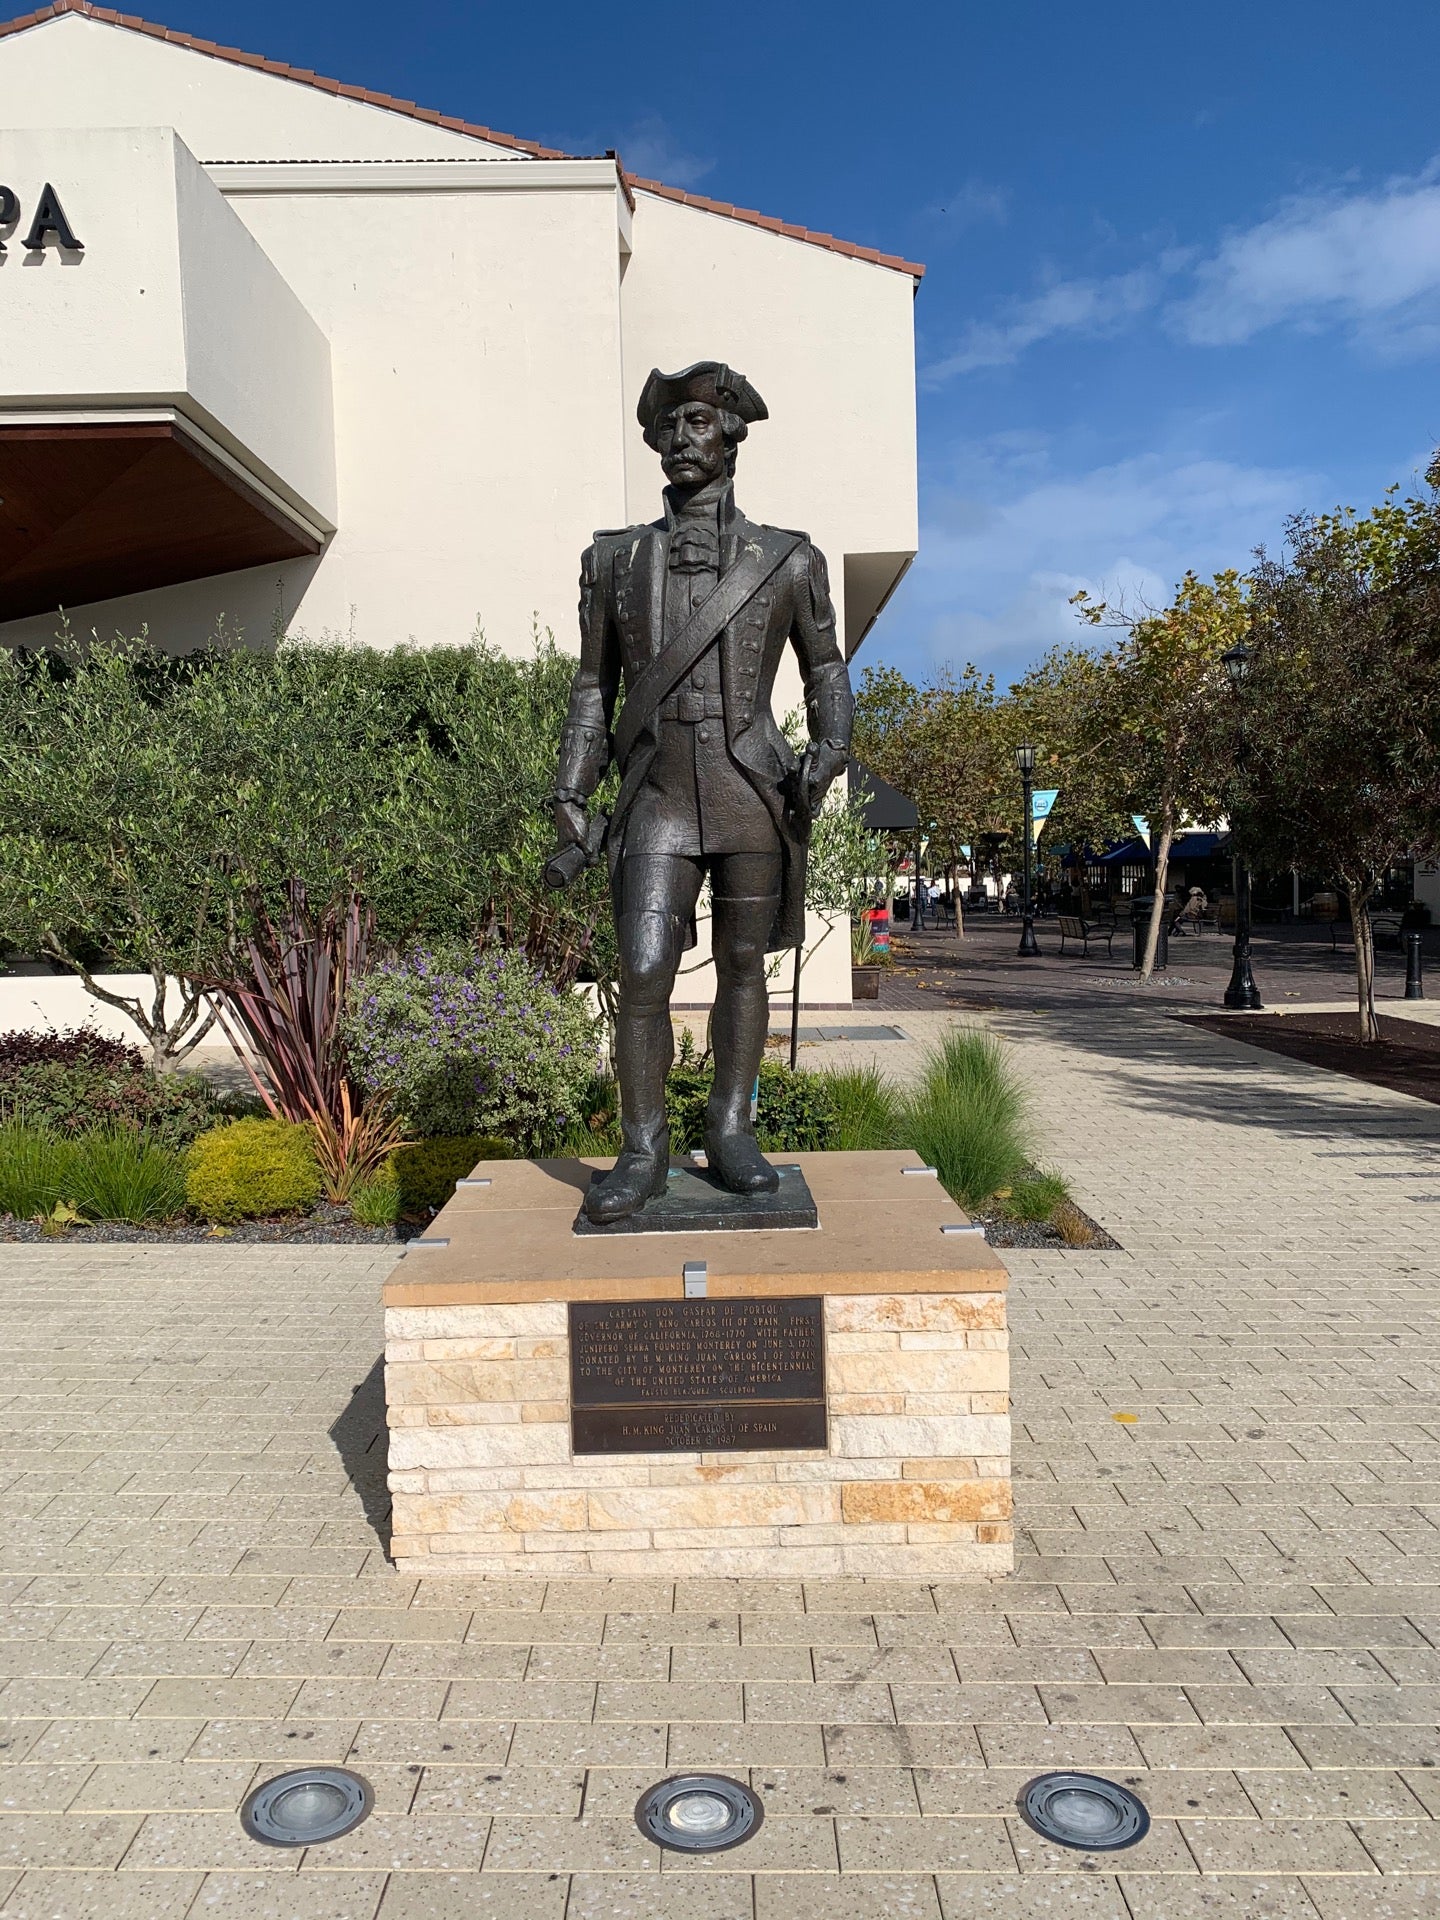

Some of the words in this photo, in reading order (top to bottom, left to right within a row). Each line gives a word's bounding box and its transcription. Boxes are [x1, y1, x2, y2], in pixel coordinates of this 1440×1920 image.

[609, 1308, 647, 1319] CAPTAIN
[655, 1307, 674, 1317] DON
[682, 1306, 716, 1317] GASPAR
[724, 1305, 734, 1315] DE
[743, 1304, 784, 1315] PORTOLA
[578, 1322, 589, 1331] OF
[594, 1321, 610, 1330] THE
[615, 1320, 638, 1330] ARMY
[643, 1320, 652, 1329] OF
[658, 1319, 679, 1329] KING
[684, 1318, 716, 1328] CARLOS
[721, 1318, 732, 1327] III
[737, 1317, 748, 1326] OF
[790, 1315, 816, 1325] FIRST
[578, 1332, 623, 1342] GOVERNOR
[628, 1332, 638, 1341] OF
[644, 1330, 699, 1340] CALIFORNIA,
[756, 1328, 778, 1337] WITH
[783, 1327, 815, 1336] FATHER
[580, 1344, 618, 1354] JUNIPERO
[623, 1343, 649, 1352] SERRA
[654, 1342, 691, 1352] FOUNDED
[696, 1340, 741, 1350] MONTEREY
[746, 1340, 757, 1349] ON
[762, 1339, 783, 1349] JUNE
[580, 1355, 620, 1365] DONATED
[626, 1354, 637, 1364] BY
[668, 1353, 689, 1363] KING
[695, 1352, 717, 1362] JUAN
[723, 1351, 757, 1361] CARLOS
[773, 1350, 783, 1360] OF
[790, 1350, 816, 1359] SPAIN
[580, 1367, 591, 1376] TO
[596, 1366, 612, 1376] THE
[617, 1366, 637, 1376] CITY
[642, 1365, 653, 1375] OF
[659, 1364, 706, 1374] MONTEREY
[712, 1364, 723, 1373] ON
[729, 1363, 745, 1373] THE
[751, 1361, 816, 1372] BICENTENNIAL
[614, 1377, 625, 1387] OF
[630, 1376, 647, 1386] THE
[652, 1375, 685, 1386] UNITED
[690, 1374, 723, 1385] STATES
[728, 1374, 738, 1384] OF
[641, 1388, 668, 1396] FAUSTO
[719, 1386, 756, 1395] SCULPTOR
[664, 1412, 718, 1424] REDEDICATED
[724, 1411, 735, 1422] BY
[644, 1425, 664, 1435] KING
[669, 1424, 690, 1435] JUAN
[695, 1423, 726, 1434] CARLOS
[738, 1423, 749, 1433] OF
[753, 1422, 777, 1432] SPAIN
[664, 1435, 700, 1446] OCTOBER
[717, 1435, 736, 1445] 1987
